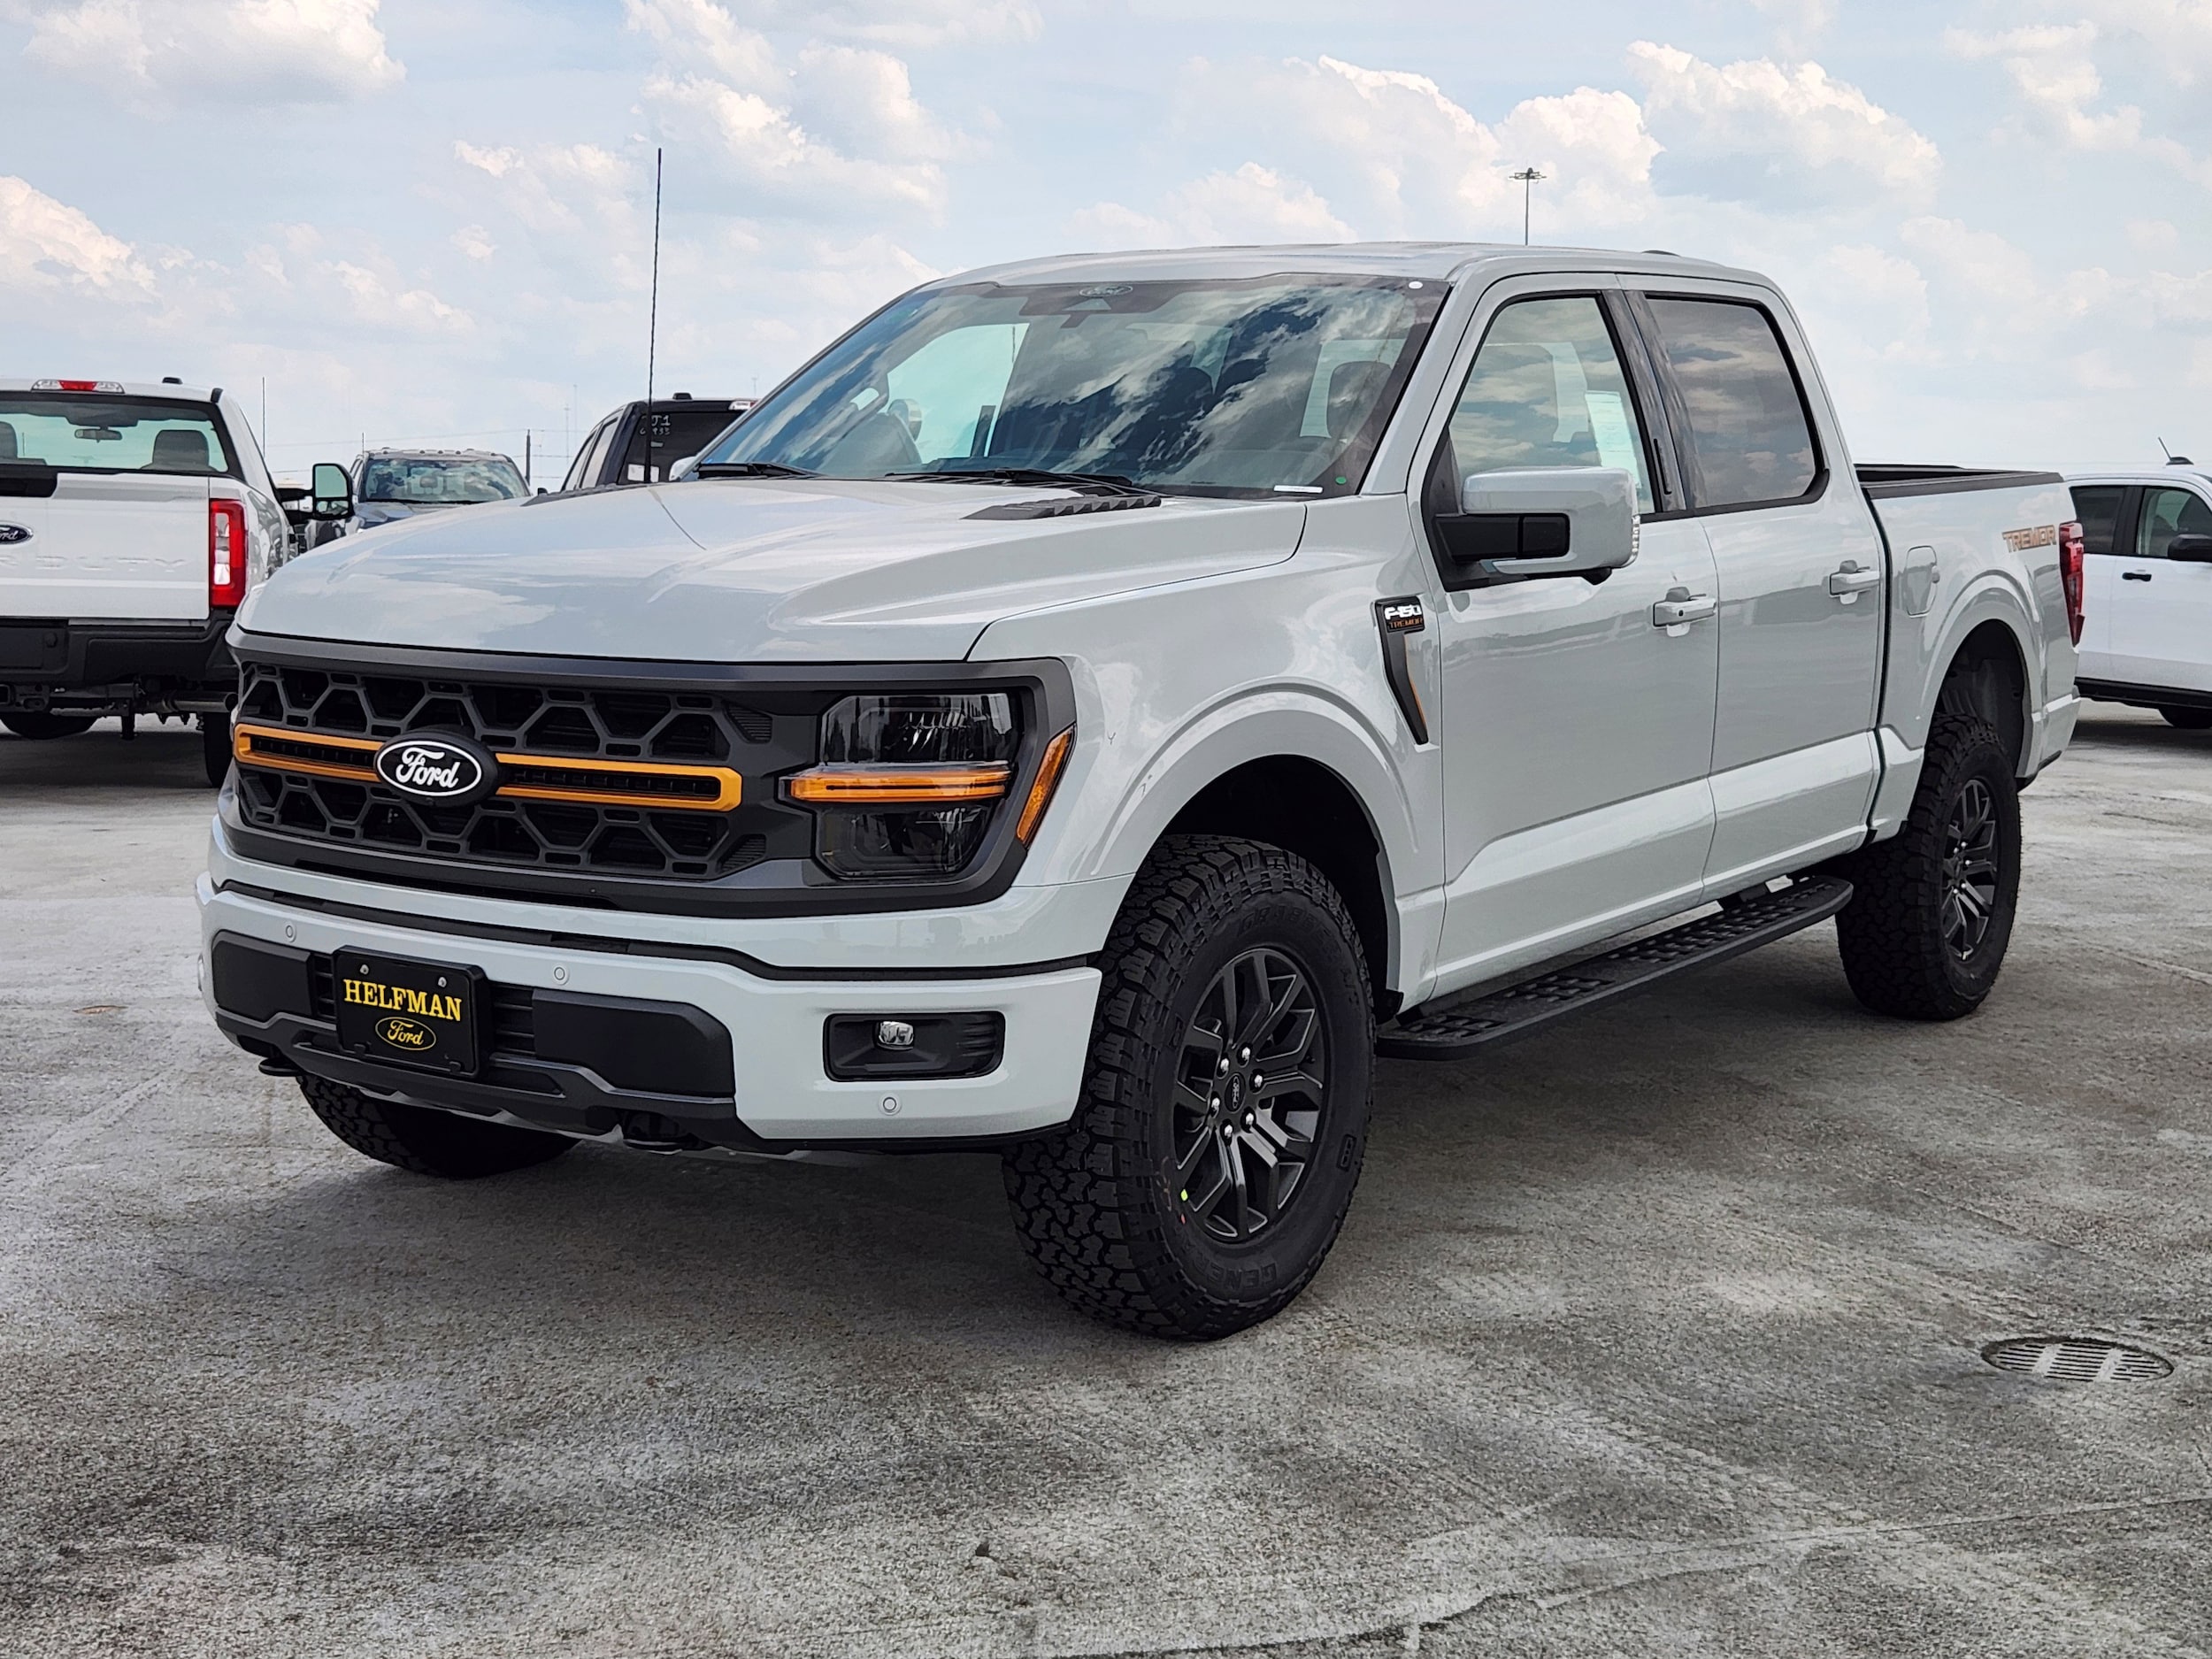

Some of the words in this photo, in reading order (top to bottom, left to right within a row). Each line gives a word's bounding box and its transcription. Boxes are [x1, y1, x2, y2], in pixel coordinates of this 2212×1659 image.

[2001, 525, 2057, 553] TREMOR
[1384, 604, 1423, 620] F-150
[396, 747, 461, 788] Ford
[342, 979, 463, 1022] HELFMAN
[387, 1019, 425, 1046] Ford
